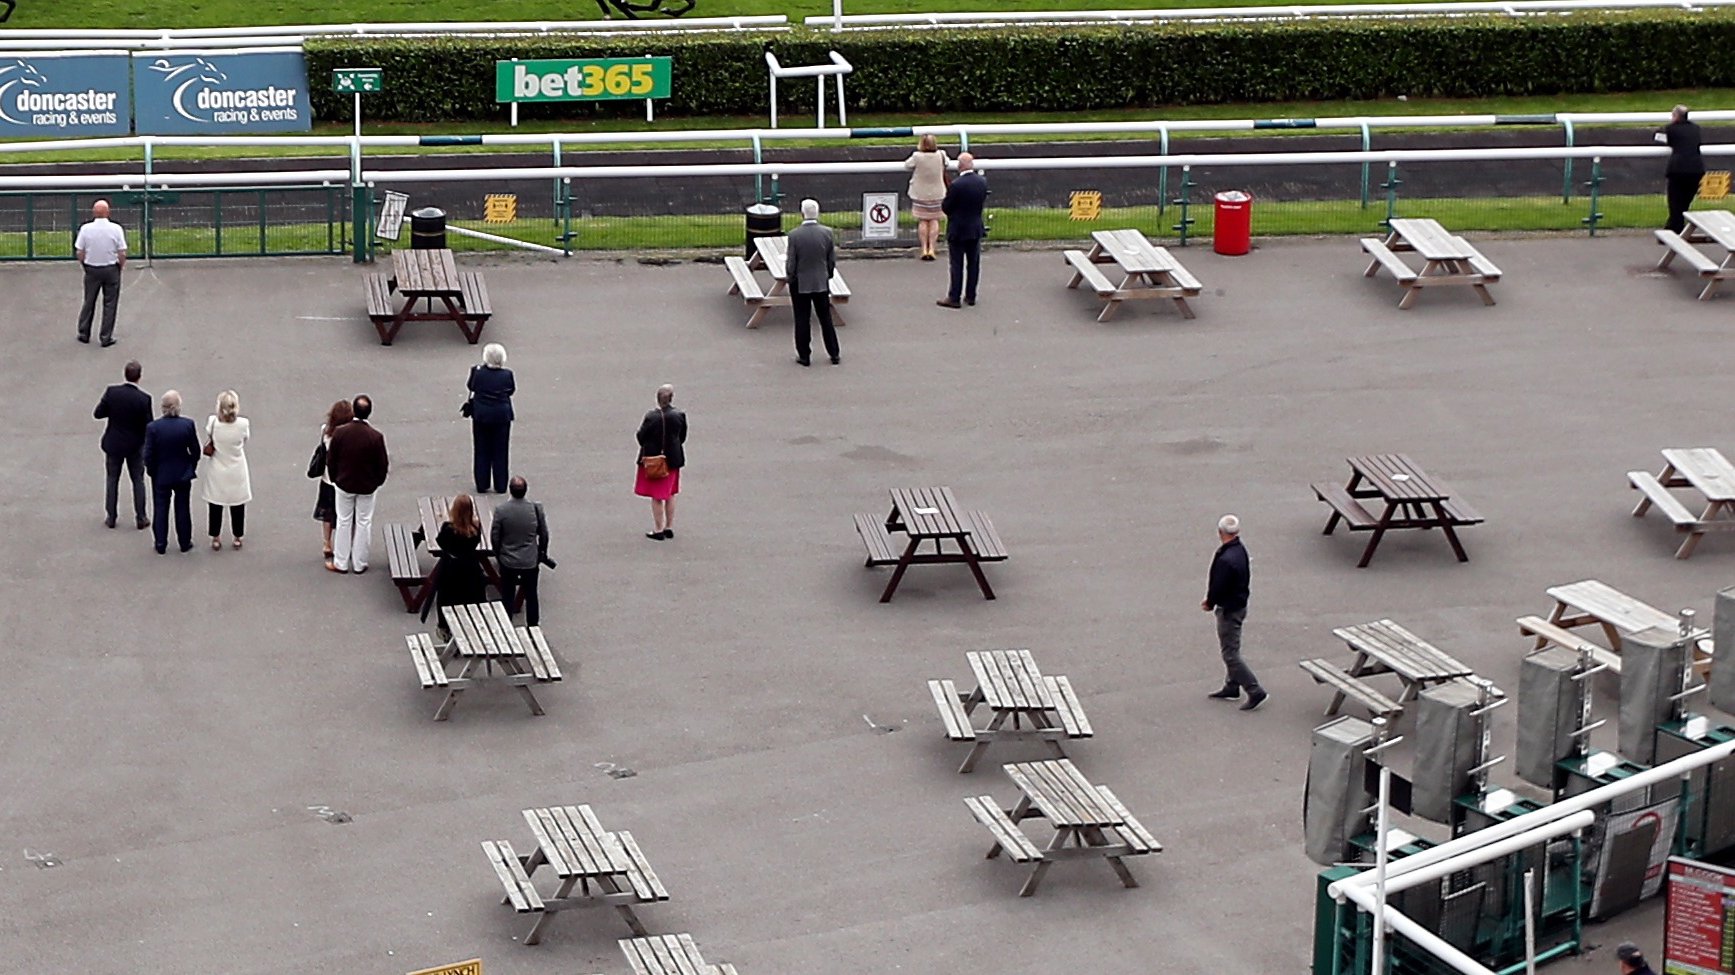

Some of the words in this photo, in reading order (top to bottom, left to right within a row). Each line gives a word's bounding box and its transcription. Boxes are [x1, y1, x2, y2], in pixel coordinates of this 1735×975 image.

[515, 63, 653, 98] bet365
[17, 90, 117, 111] doncaster
[197, 86, 296, 109] doncaster
[32, 112, 66, 127] racing
[69, 111, 80, 124] &
[81, 111, 117, 124] events
[214, 109, 246, 124] racing
[249, 108, 260, 121] &
[261, 108, 297, 120] events
